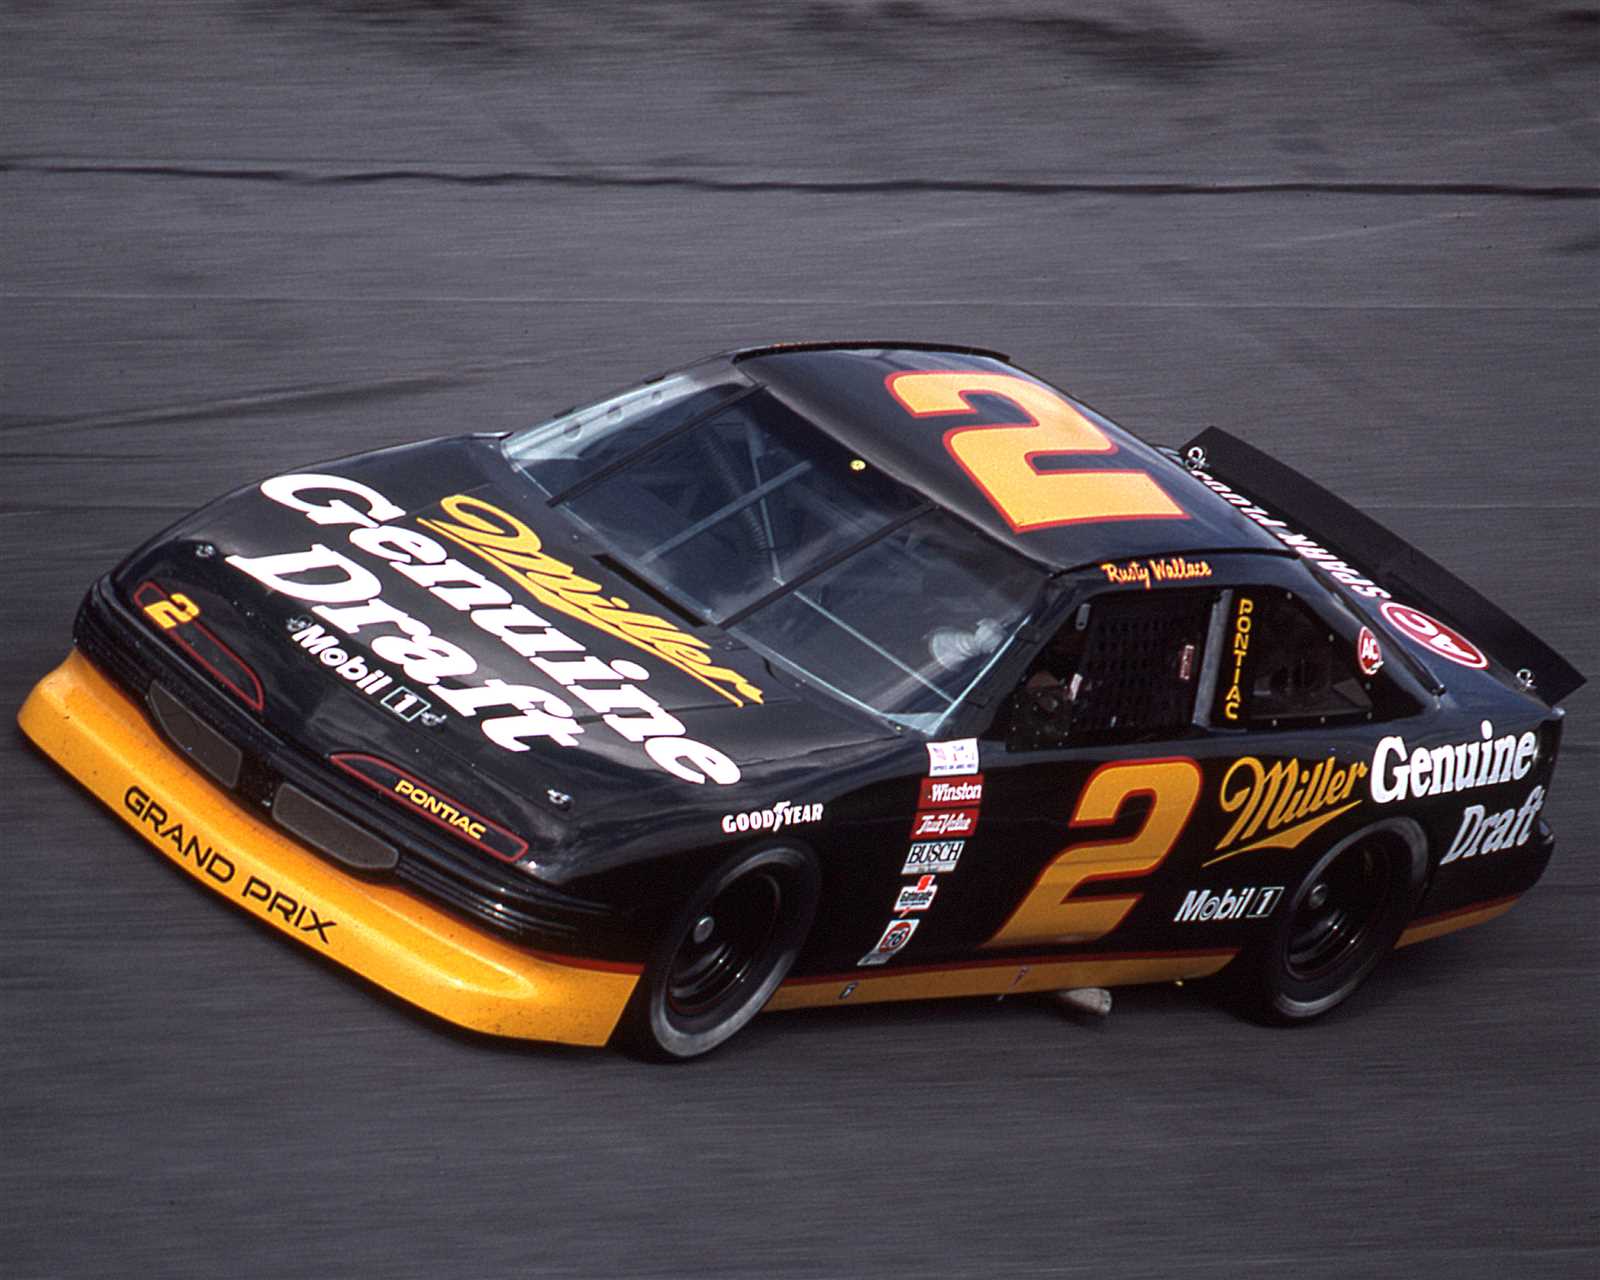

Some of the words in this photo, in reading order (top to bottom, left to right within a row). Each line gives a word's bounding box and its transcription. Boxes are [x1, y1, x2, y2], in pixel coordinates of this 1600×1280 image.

[884, 370, 1191, 534] 2
[144, 593, 199, 629] 2
[417, 494, 764, 708] Miller
[1101, 561, 1151, 588] Rusty
[1150, 557, 1212, 581] Wallace
[225, 543, 585, 752] Draft
[260, 474, 742, 785] Genuine
[293, 624, 394, 697] Mobil
[1225, 598, 1254, 719] PONTIAC
[393, 779, 487, 841] PONTIAC
[721, 801, 823, 832] GOODYEAR
[931, 782, 982, 802] Winston
[1215, 756, 1369, 852] Miller
[1370, 720, 1537, 803] Genuine
[1440, 786, 1544, 865] Draft
[123, 785, 236, 884] GRAND
[241, 876, 338, 944] PRIX
[908, 843, 961, 864] BUSCH
[984, 756, 1202, 948] 2
[1174, 886, 1256, 922] Mobil
